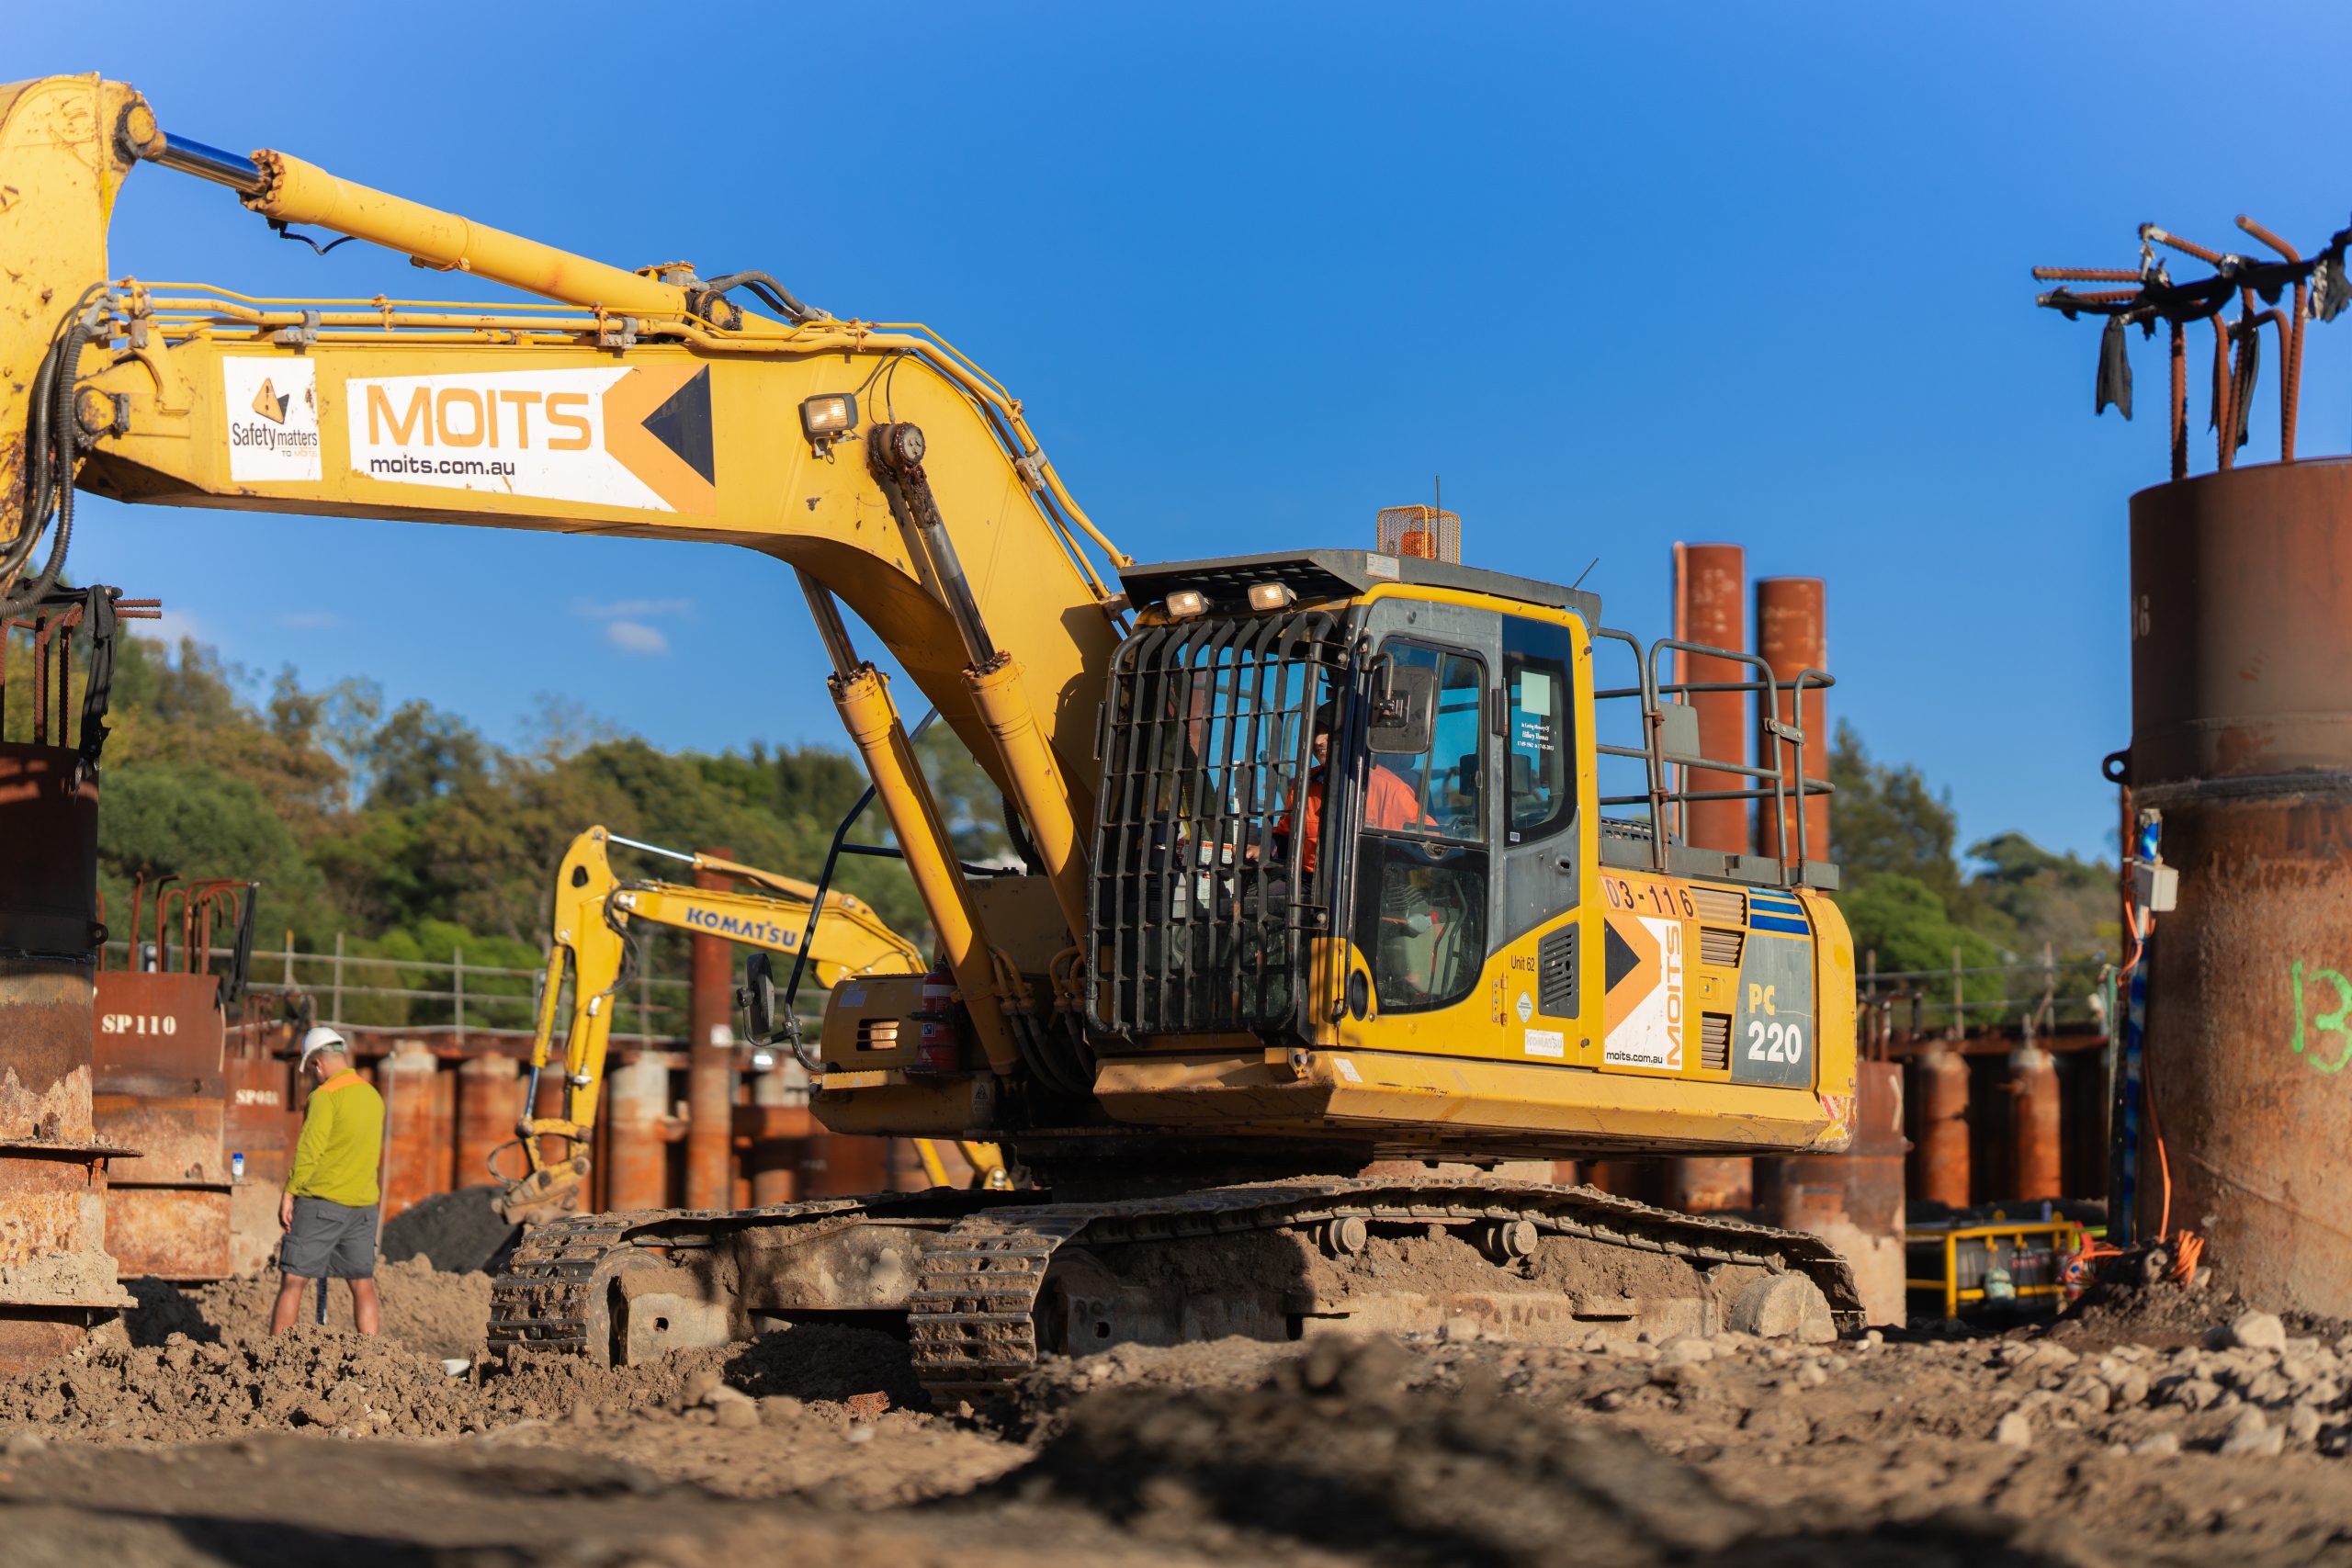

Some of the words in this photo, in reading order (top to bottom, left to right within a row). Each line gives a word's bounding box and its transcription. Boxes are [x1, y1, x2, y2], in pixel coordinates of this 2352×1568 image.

[367, 385, 592, 450] MOITS
[232, 423, 276, 450] Safety
[277, 430, 317, 446] matters
[370, 455, 515, 476] moits.com.au
[1605, 879, 1693, 918] 03-116
[686, 907, 797, 947] KOMATSU
[1510, 954, 1525, 971] Unit
[1527, 957, 1535, 972] 62
[1666, 925, 1680, 1066] MOITS
[1748, 983, 1775, 1016] PC
[102, 1014, 177, 1036] SP110
[1606, 1050, 1663, 1064] moits.com.au
[1747, 1021, 1802, 1065] 220
